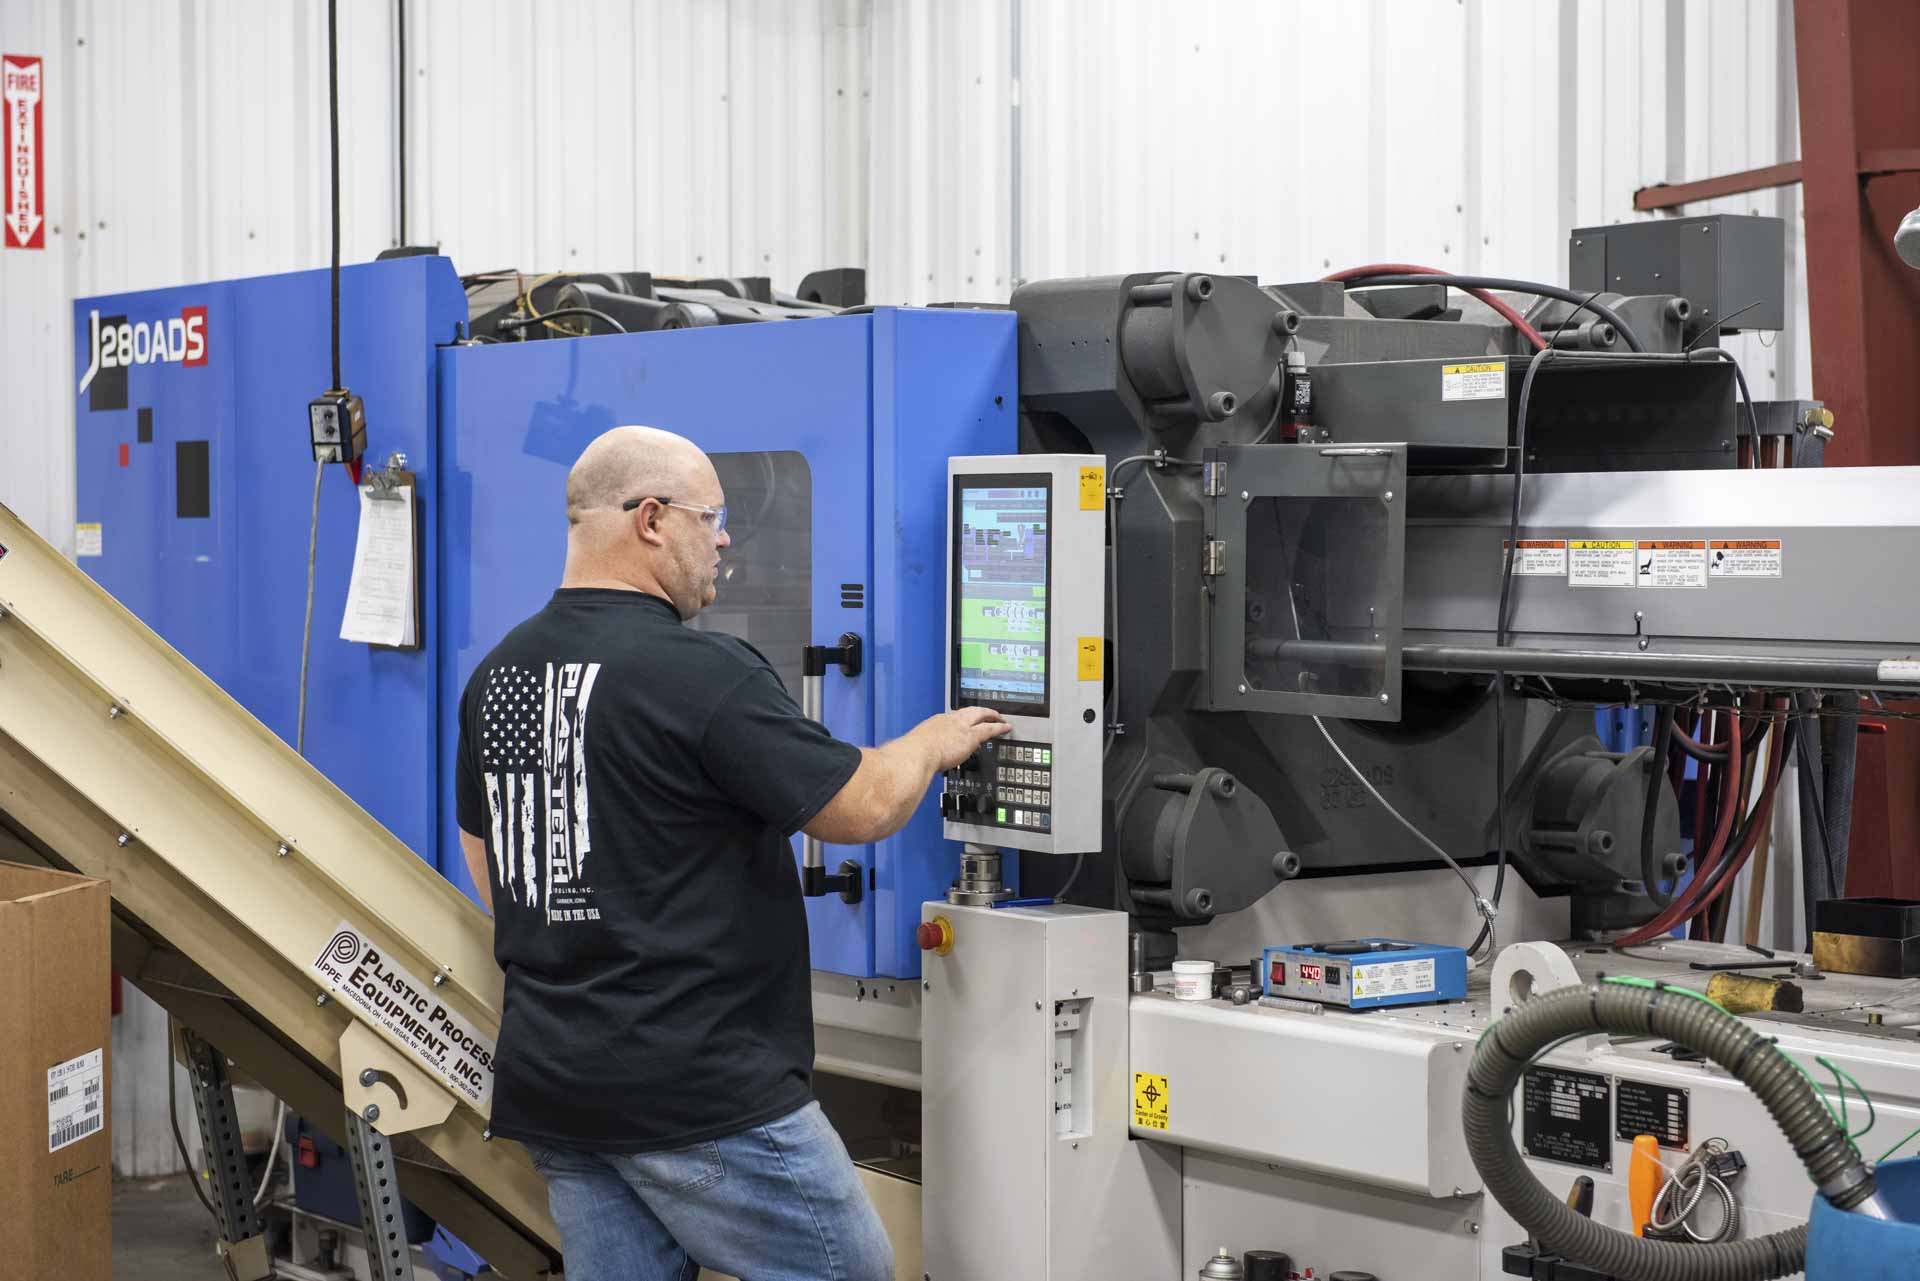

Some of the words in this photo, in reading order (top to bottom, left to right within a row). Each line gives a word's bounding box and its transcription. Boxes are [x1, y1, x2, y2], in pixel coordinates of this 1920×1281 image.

[8, 74, 37, 92] FIRE
[17, 100, 30, 233] EXTINGUISHER
[80, 309, 204, 395] J280ADS
[1591, 541, 1621, 549] CAUTION
[1662, 541, 1693, 549] WARNING
[1735, 541, 1768, 549] WARNING
[563, 910, 572, 921] IN
[572, 909, 586, 921] THE
[586, 908, 601, 920] USA
[320, 962, 343, 984] PPE
[360, 948, 428, 1013] PLASTIC
[1301, 964, 1321, 980] 440
[372, 1009, 381, 1019] OH
[382, 1018, 393, 1029] LAS
[348, 966, 450, 1063] EQUIPMENT,
[454, 1058, 482, 1091] INC.
[53, 1168, 74, 1186] TARE
